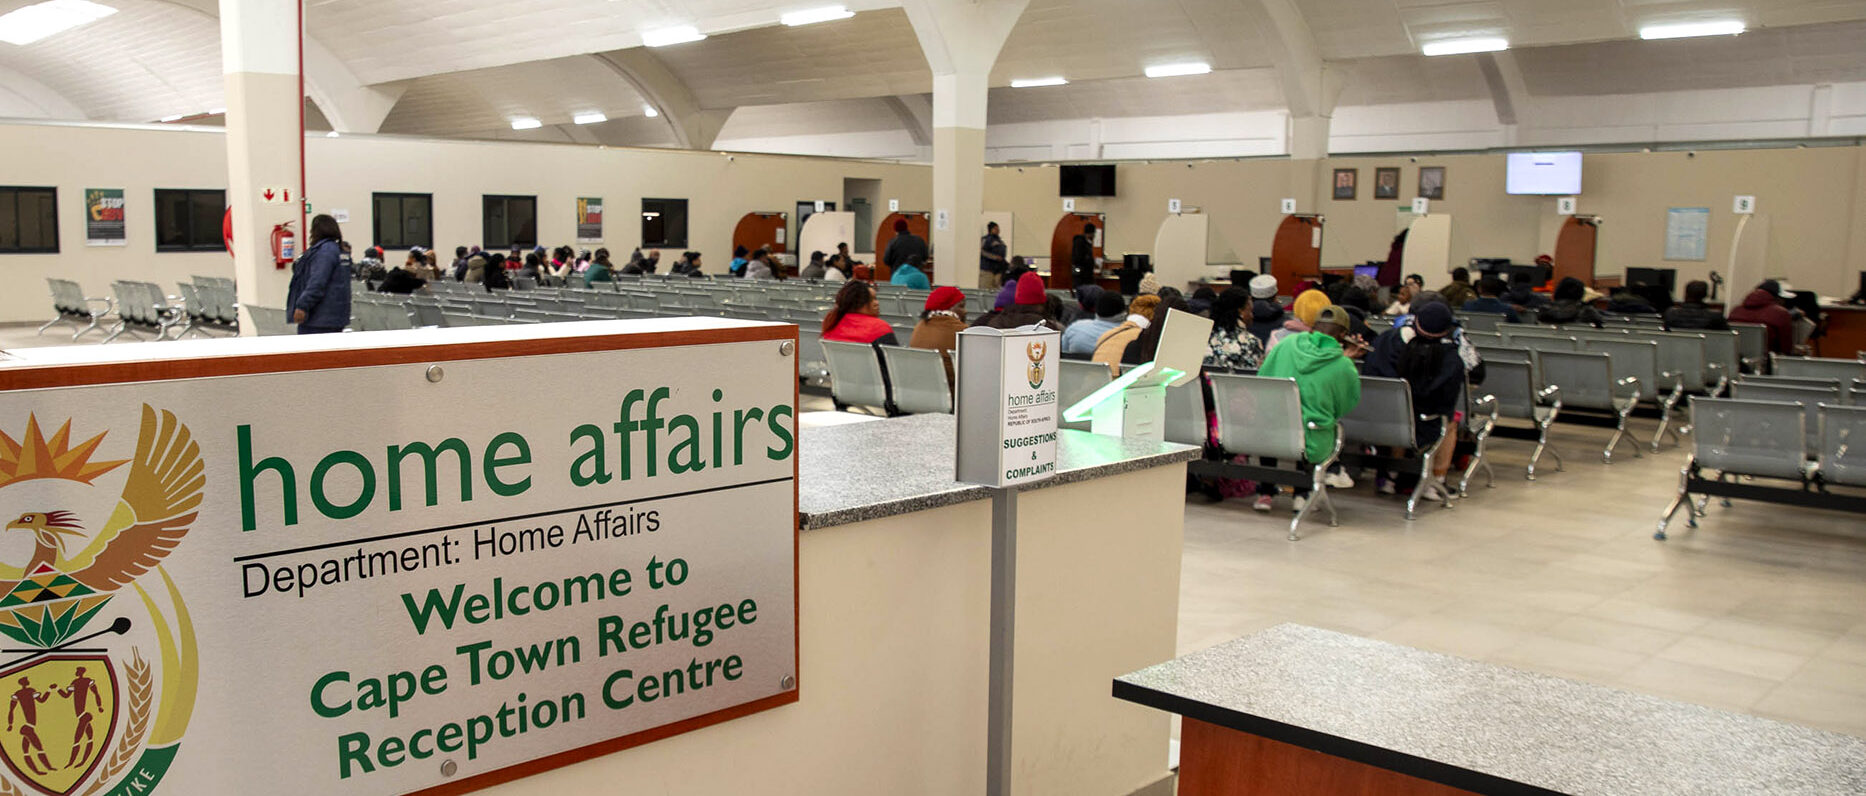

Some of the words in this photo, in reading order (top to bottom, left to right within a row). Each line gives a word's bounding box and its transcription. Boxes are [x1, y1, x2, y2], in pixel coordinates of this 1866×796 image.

[1008, 394, 1033, 406] home
[1036, 389, 1055, 403] affairs
[238, 425, 530, 531] home
[571, 388, 792, 486] affairs
[1003, 431, 1057, 449] SUGGESTIONS
[1006, 462, 1054, 480] COMPLAINTS
[1031, 451, 1037, 461] &
[242, 539, 460, 598] Department:
[474, 525, 564, 560] Home
[573, 510, 661, 544] Affairs
[403, 570, 631, 634] Welcome
[647, 558, 689, 590] to
[311, 666, 447, 719] Cape
[457, 637, 580, 685] Town
[599, 599, 757, 657] Refugee
[339, 693, 585, 778] Reception
[603, 655, 742, 709] Centre
